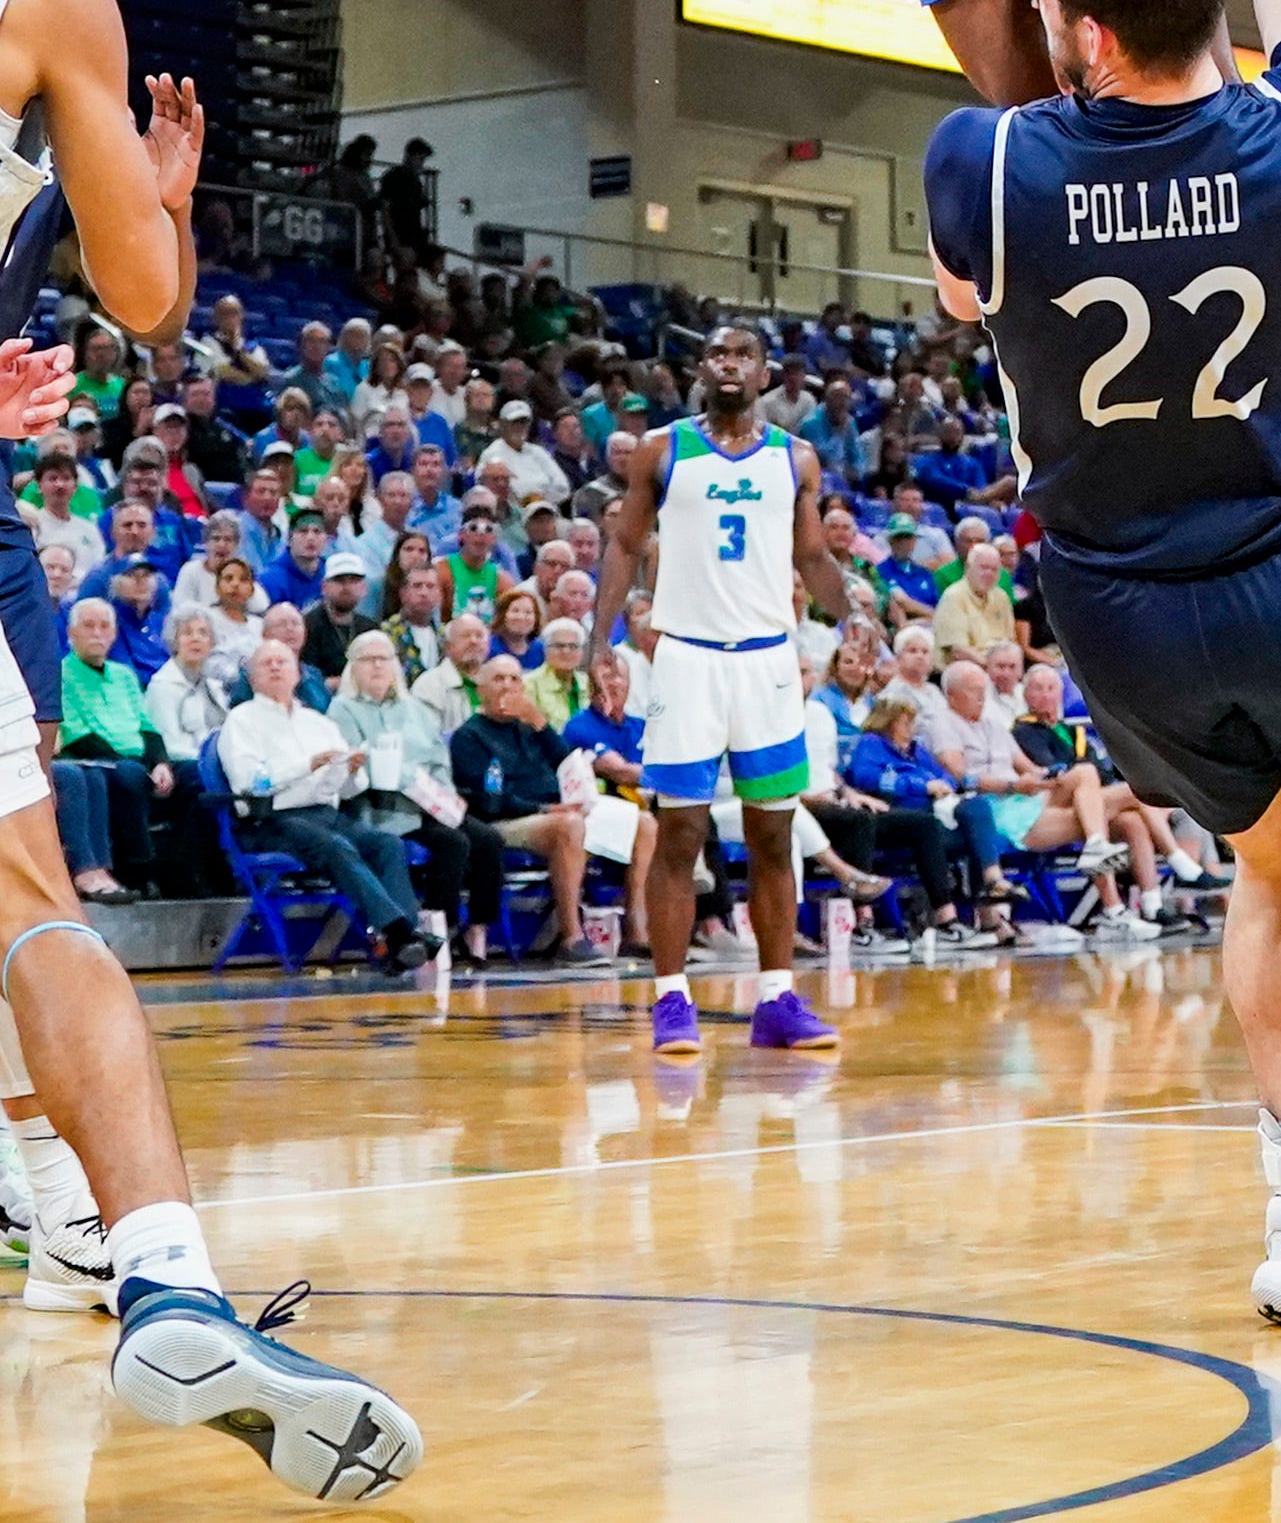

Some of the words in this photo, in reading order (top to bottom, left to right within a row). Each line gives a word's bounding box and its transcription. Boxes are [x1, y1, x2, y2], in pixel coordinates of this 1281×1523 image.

[1065, 171, 1241, 245] POLLARD
[1051, 265, 1268, 428] 22
[718, 514, 746, 561] 3
